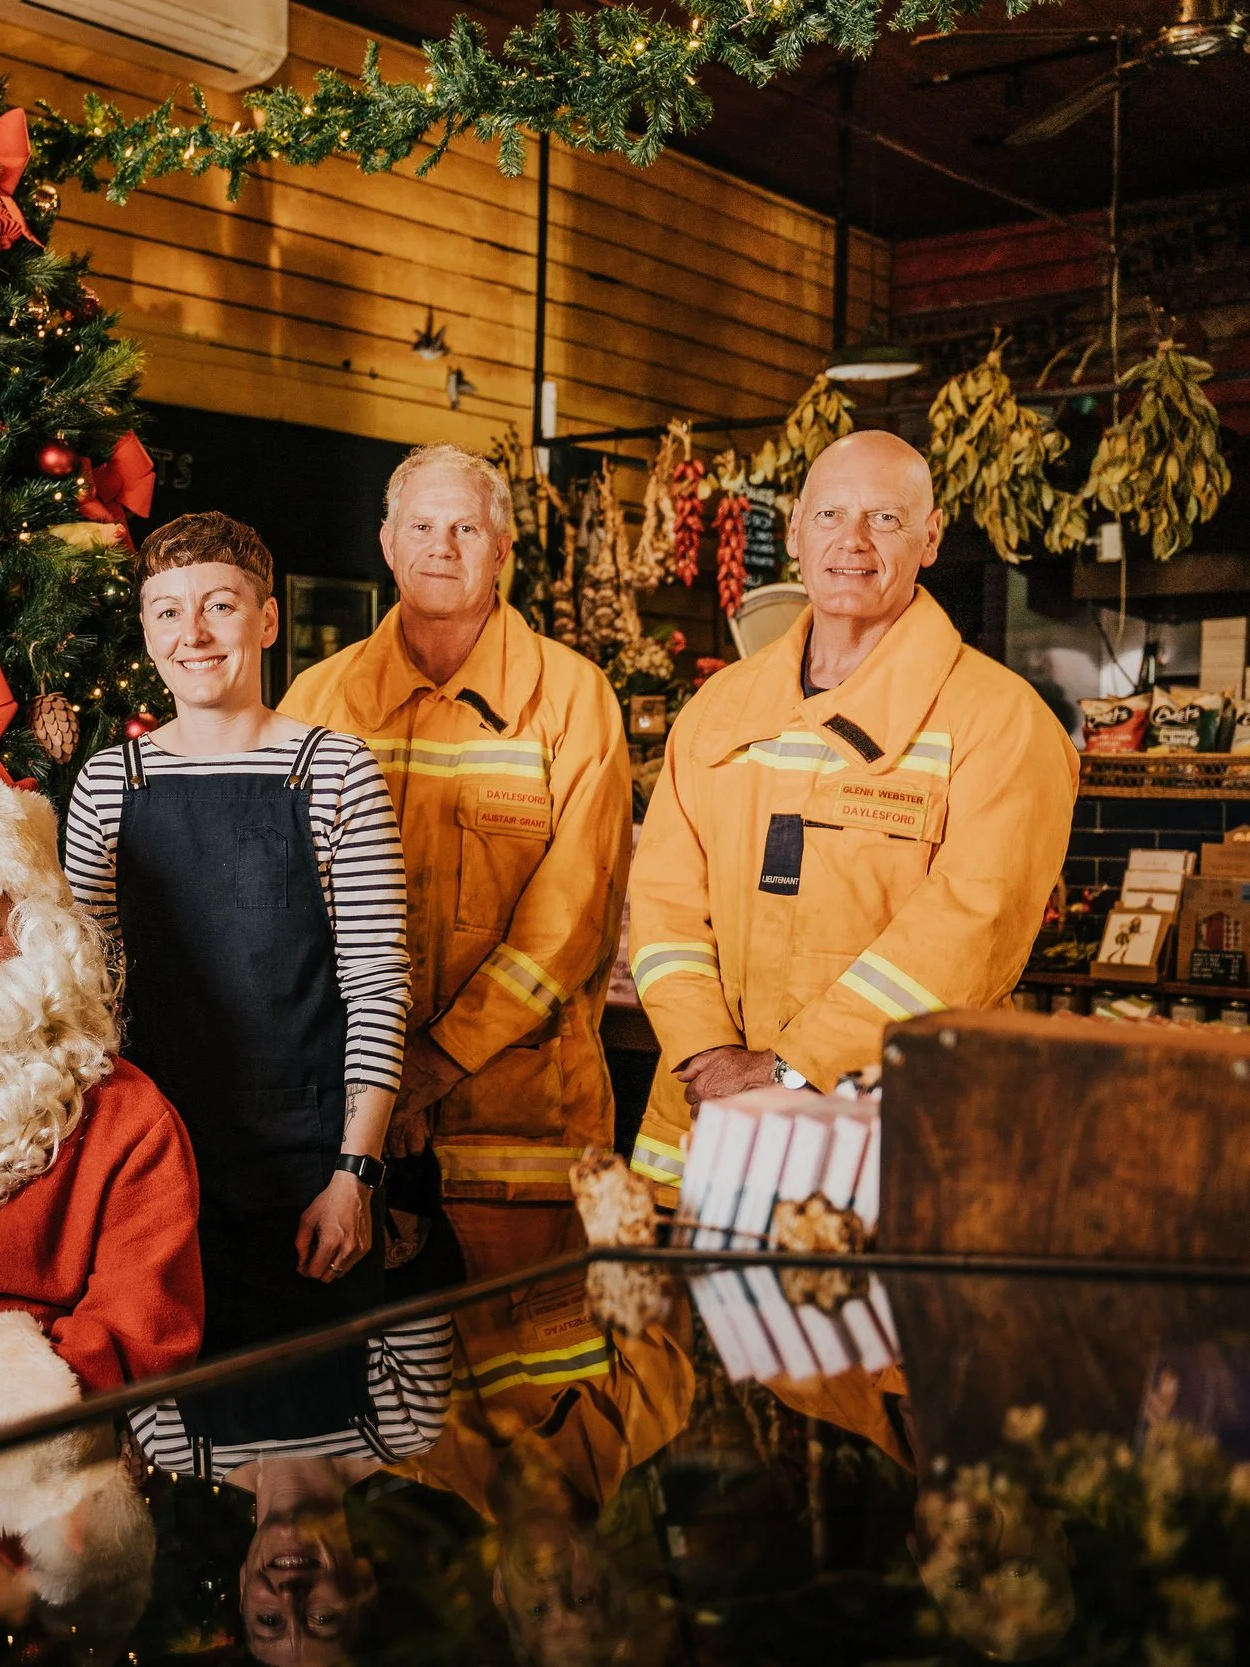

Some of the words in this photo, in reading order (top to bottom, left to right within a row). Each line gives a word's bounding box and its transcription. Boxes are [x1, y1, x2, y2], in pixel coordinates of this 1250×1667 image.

[486, 790, 546, 805] DAYLESFORD
[842, 785, 874, 797] GLENN
[878, 789, 924, 805] WEBSTER
[481, 813, 517, 825] ALISTAIR
[519, 817, 547, 829] GRANT
[842, 805, 916, 825] DAYLESFORD
[761, 875, 801, 885] LIEUTENANT
